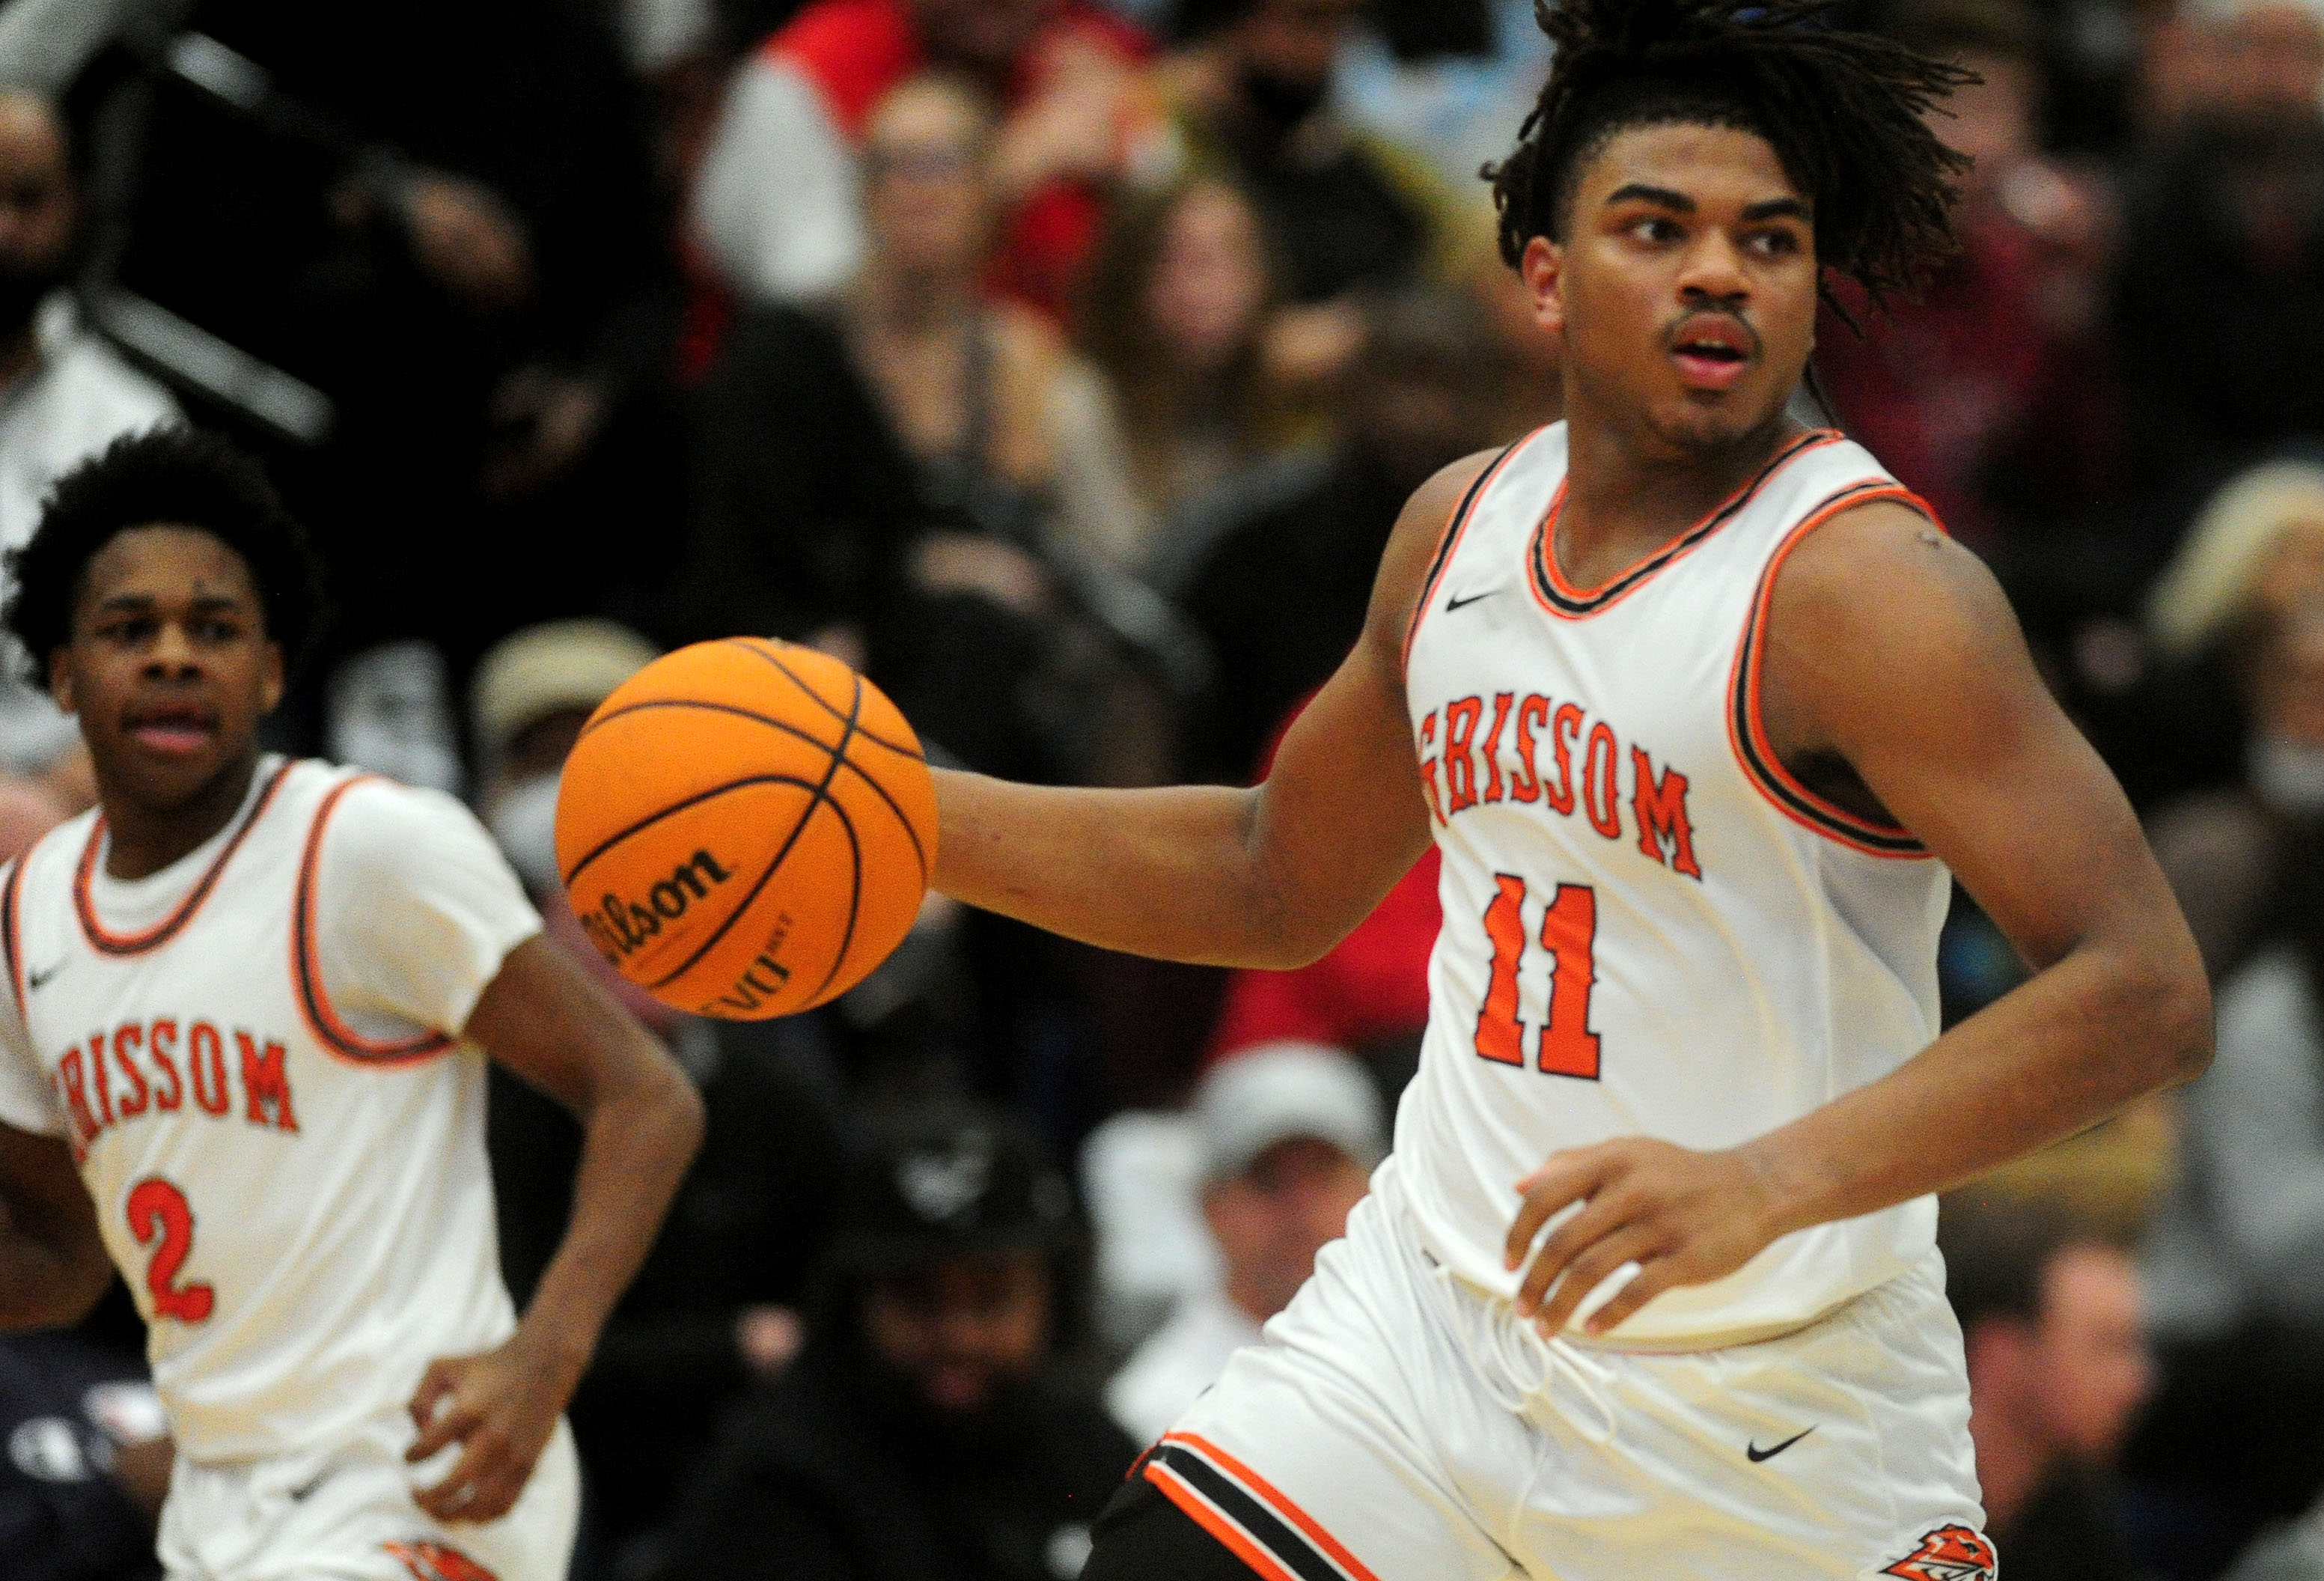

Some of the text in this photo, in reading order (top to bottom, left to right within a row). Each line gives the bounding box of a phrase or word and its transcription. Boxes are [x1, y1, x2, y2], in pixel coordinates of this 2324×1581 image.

[1474, 871, 1600, 1081] 11
[51, 1019, 301, 1165] RISSOM
[126, 1176, 216, 1326] 2
